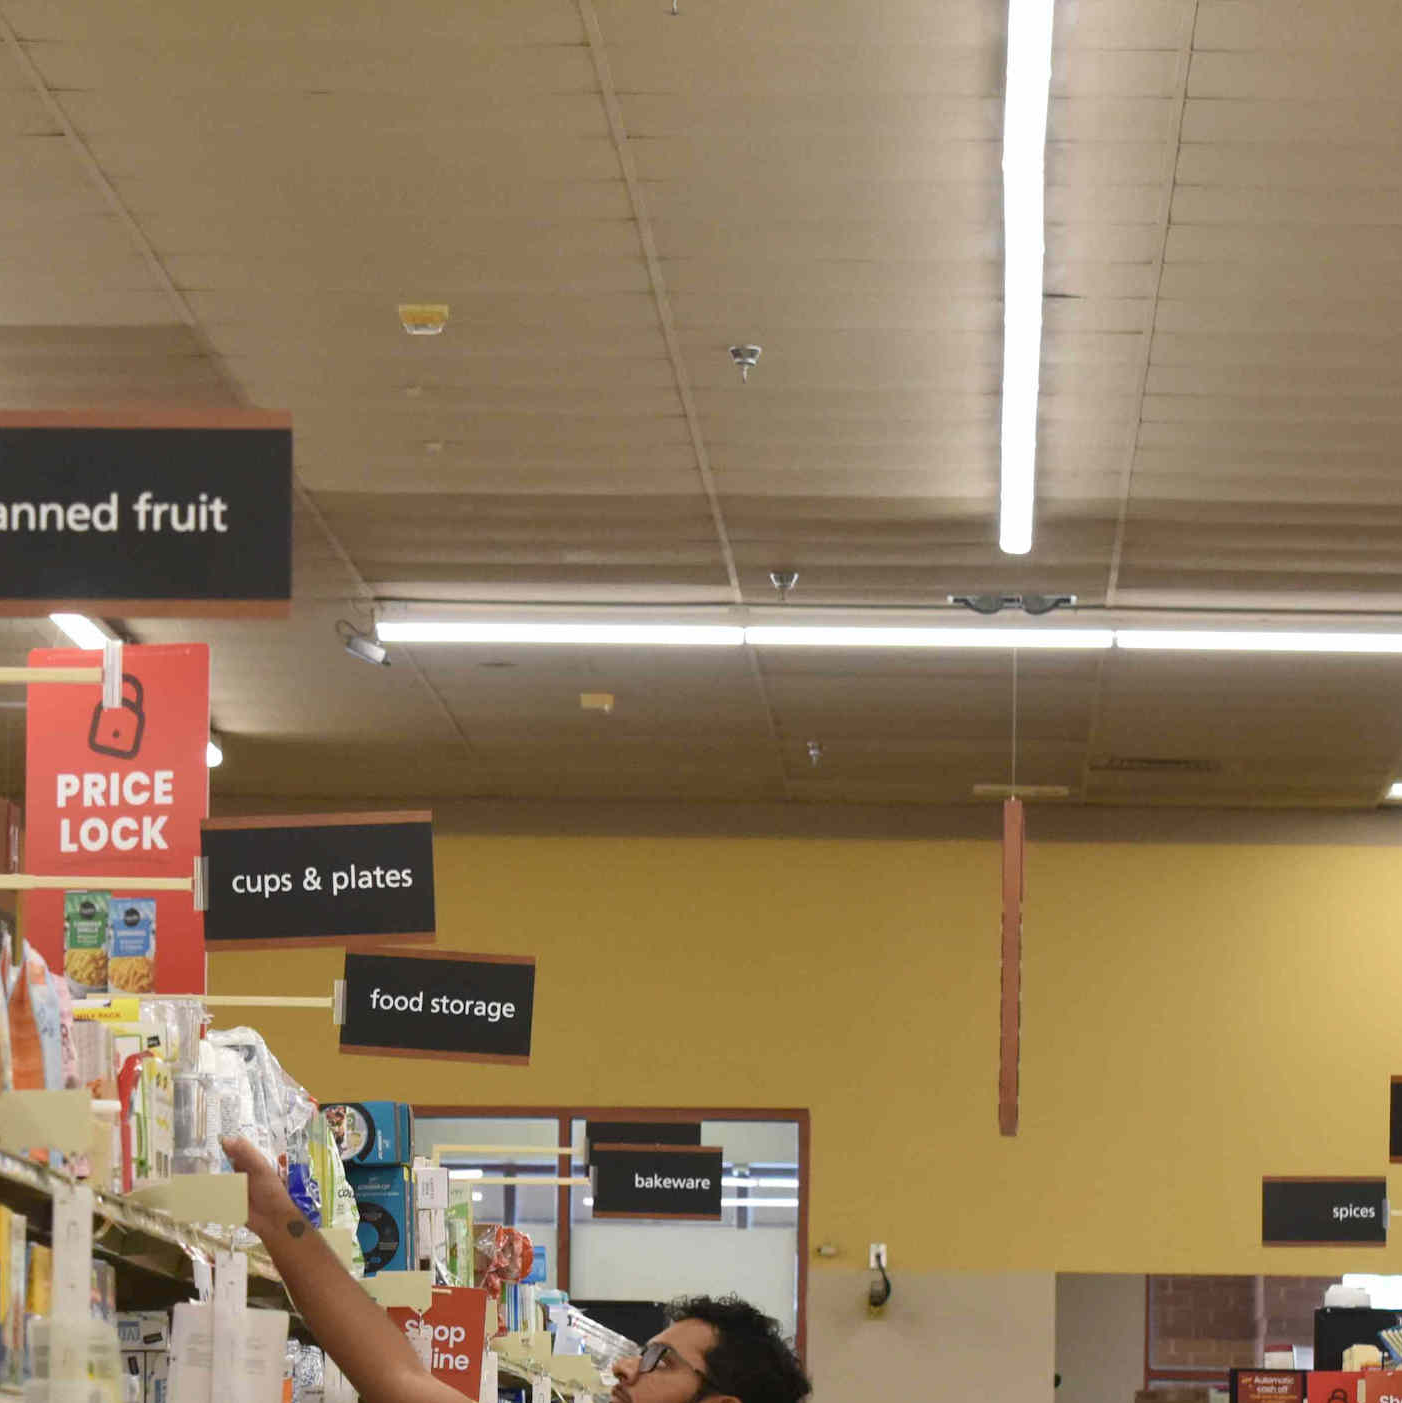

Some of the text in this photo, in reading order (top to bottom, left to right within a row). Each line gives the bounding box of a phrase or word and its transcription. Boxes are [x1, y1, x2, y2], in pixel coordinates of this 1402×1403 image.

[132, 490, 228, 534] fruit
[56, 769, 176, 809] PRICE
[60, 815, 169, 854] LOCK
[232, 862, 413, 898] cups & plates
[369, 989, 517, 1023] food storage
[634, 1172, 712, 1192] bakeware
[1332, 1200, 1376, 1221] spices
